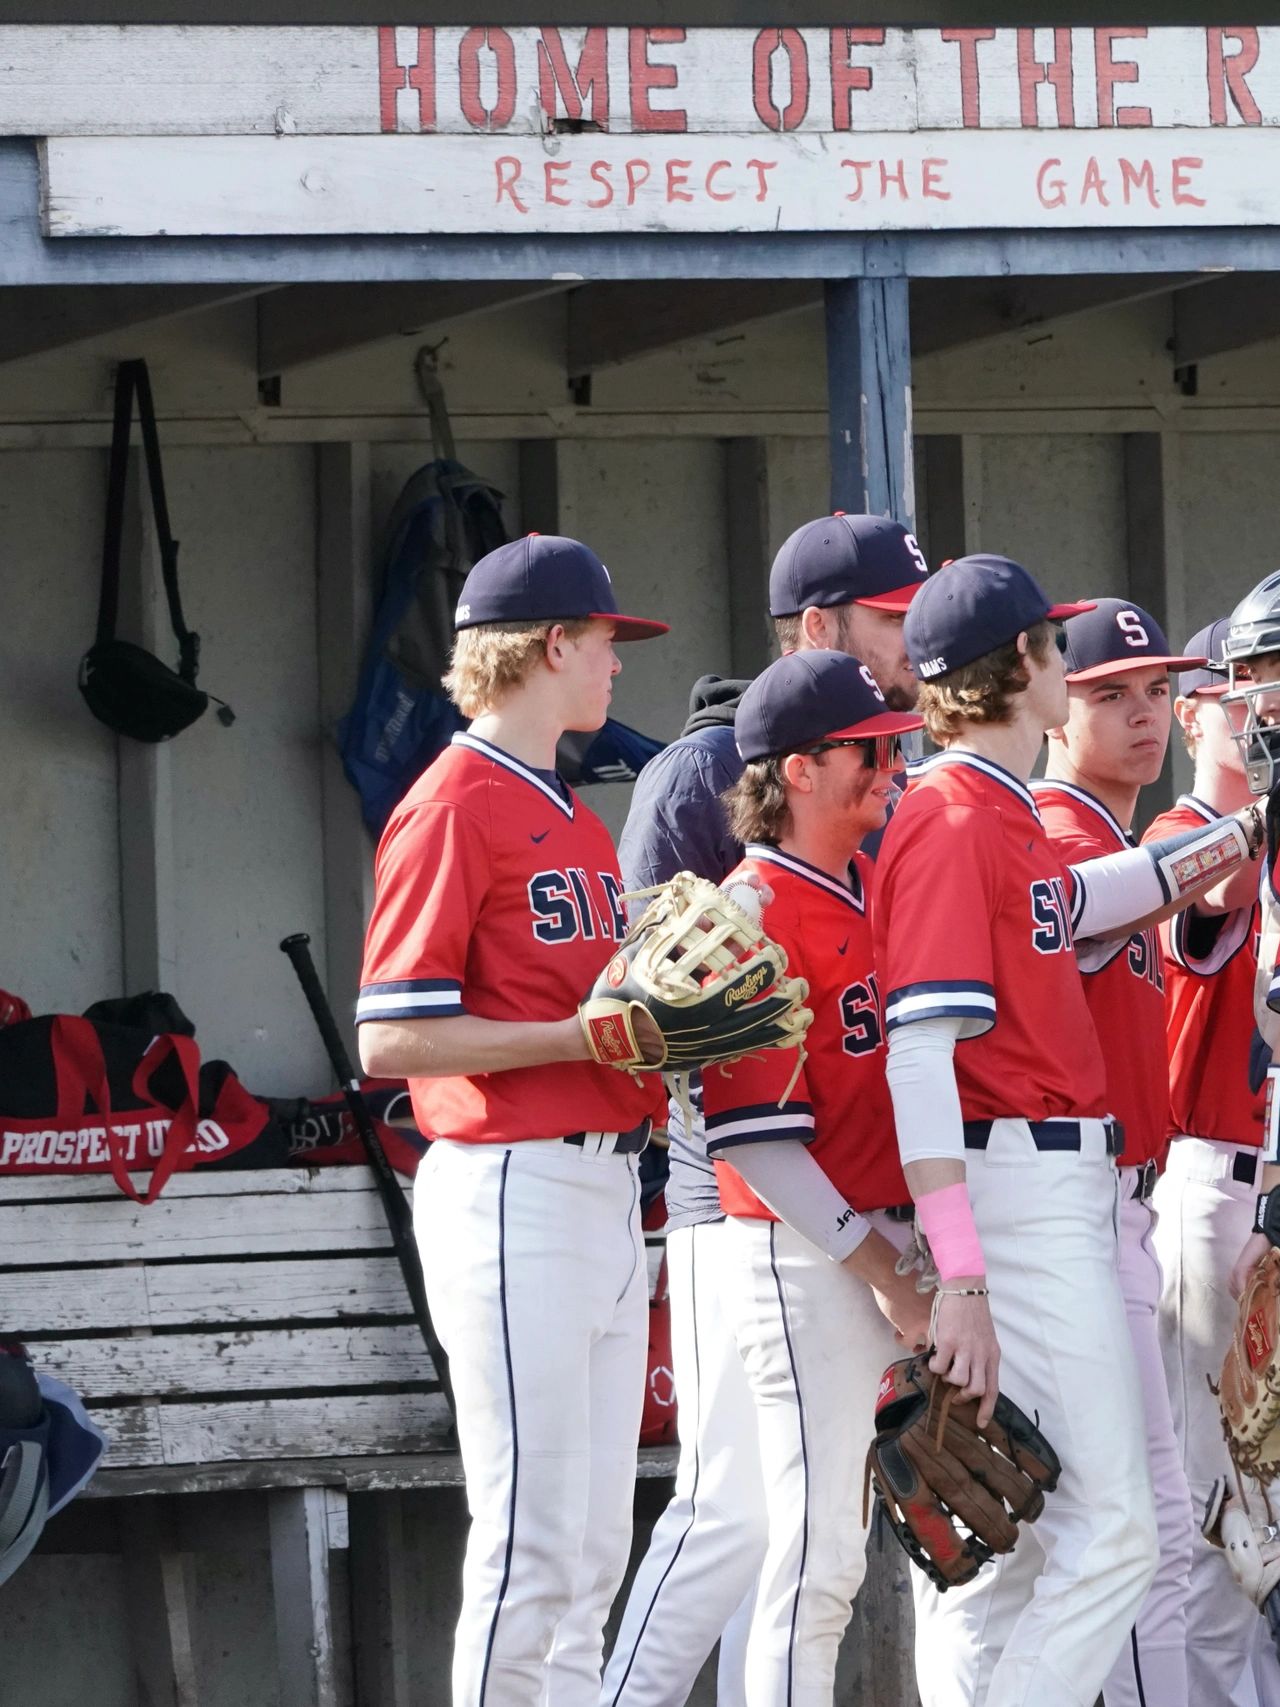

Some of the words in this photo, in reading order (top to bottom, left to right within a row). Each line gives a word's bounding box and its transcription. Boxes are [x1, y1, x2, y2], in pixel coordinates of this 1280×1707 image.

[379, 26, 687, 133] HOME
[753, 27, 885, 132] OF
[942, 27, 1152, 129] THE
[496, 156, 778, 213] RESPECT
[843, 158, 952, 201] THE
[1038, 157, 1207, 209] GAME
[1116, 610, 1150, 646] S
[859, 664, 885, 702] S
[725, 966, 768, 1007] Rawlings
